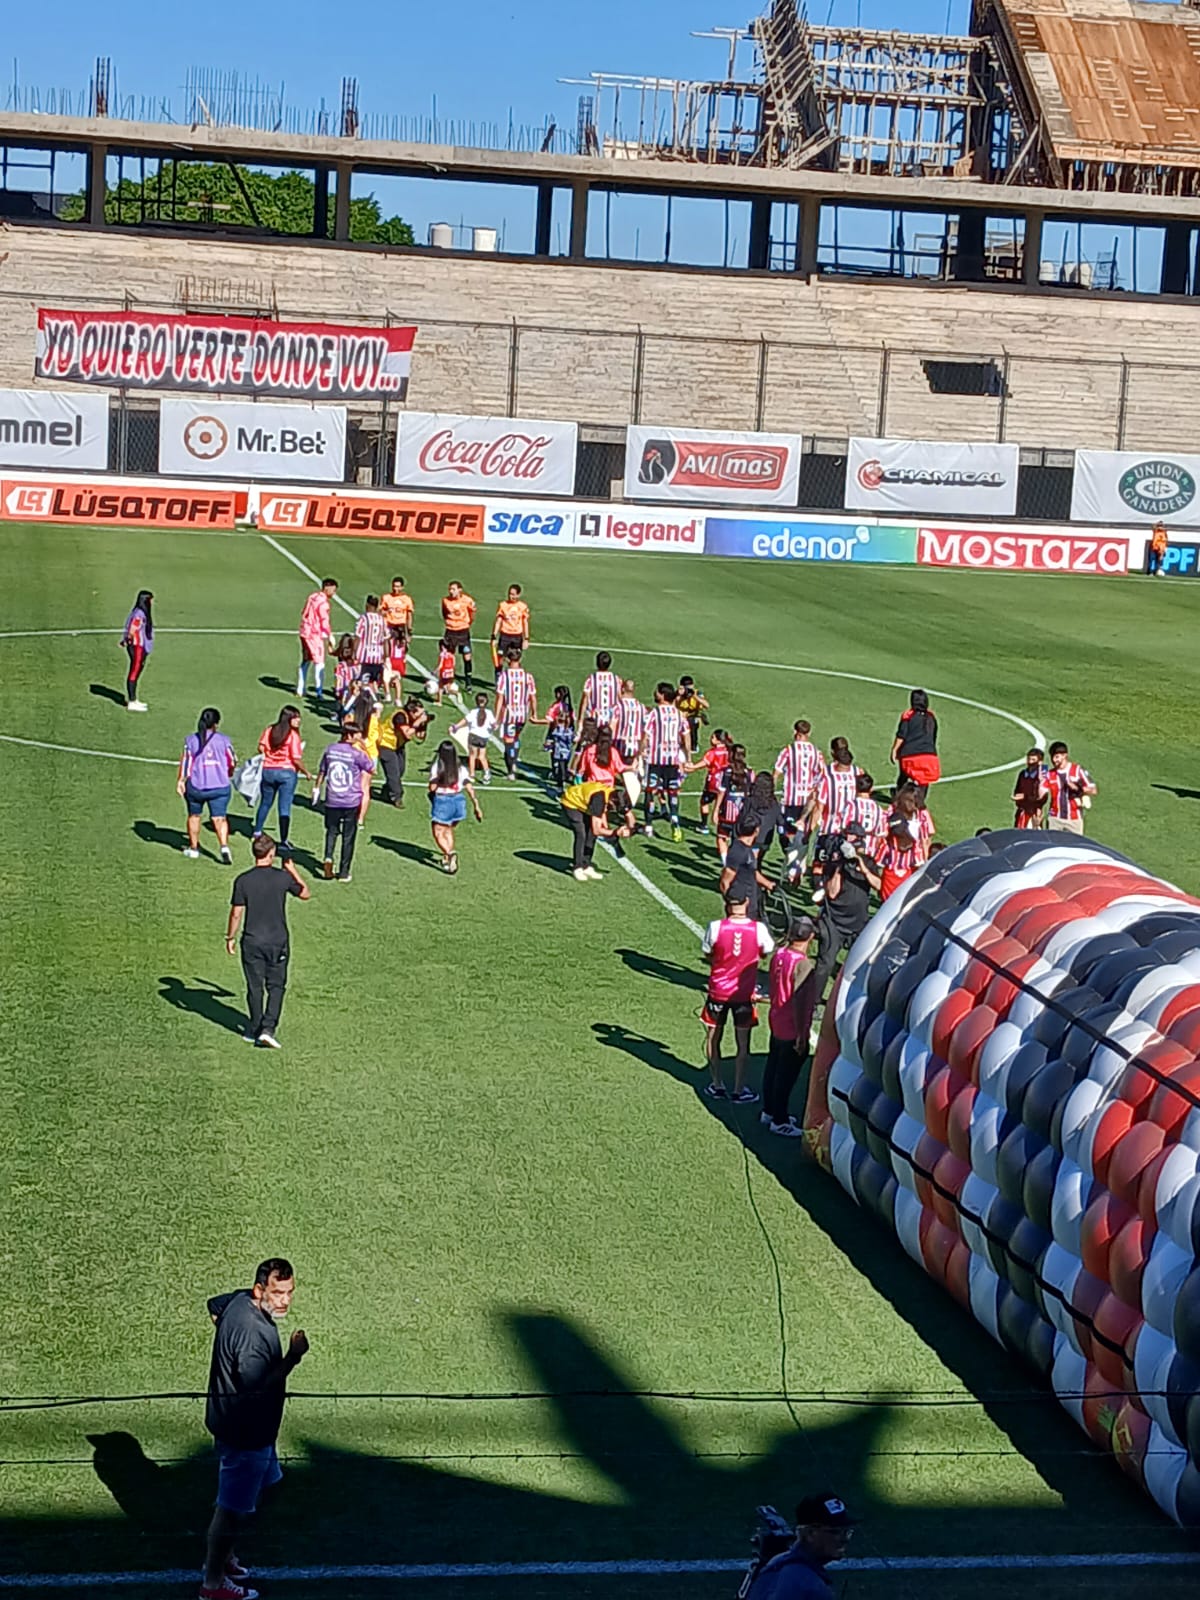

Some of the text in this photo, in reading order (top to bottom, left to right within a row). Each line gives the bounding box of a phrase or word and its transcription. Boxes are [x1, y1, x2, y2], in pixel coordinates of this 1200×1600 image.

[41, 318, 77, 375] YO
[80, 321, 167, 379] QUIERO
[171, 326, 249, 383] VERTE
[251, 334, 335, 391] DONDE
[0, 415, 82, 446] mmel
[237, 427, 326, 455] Mr.Bet
[418, 429, 553, 479] Coca-Cola
[681, 454, 773, 476] AVI mas
[883, 468, 1006, 487] CHAMICAL
[1134, 464, 1183, 480] UNION
[52, 488, 231, 523] LÜSQTOFF
[1123, 487, 1192, 512] GANADERA
[306, 500, 478, 534] LÜSQTOFF
[606, 515, 697, 547] legrand
[752, 527, 857, 561] edenor
[1149, 546, 1196, 572] PF
